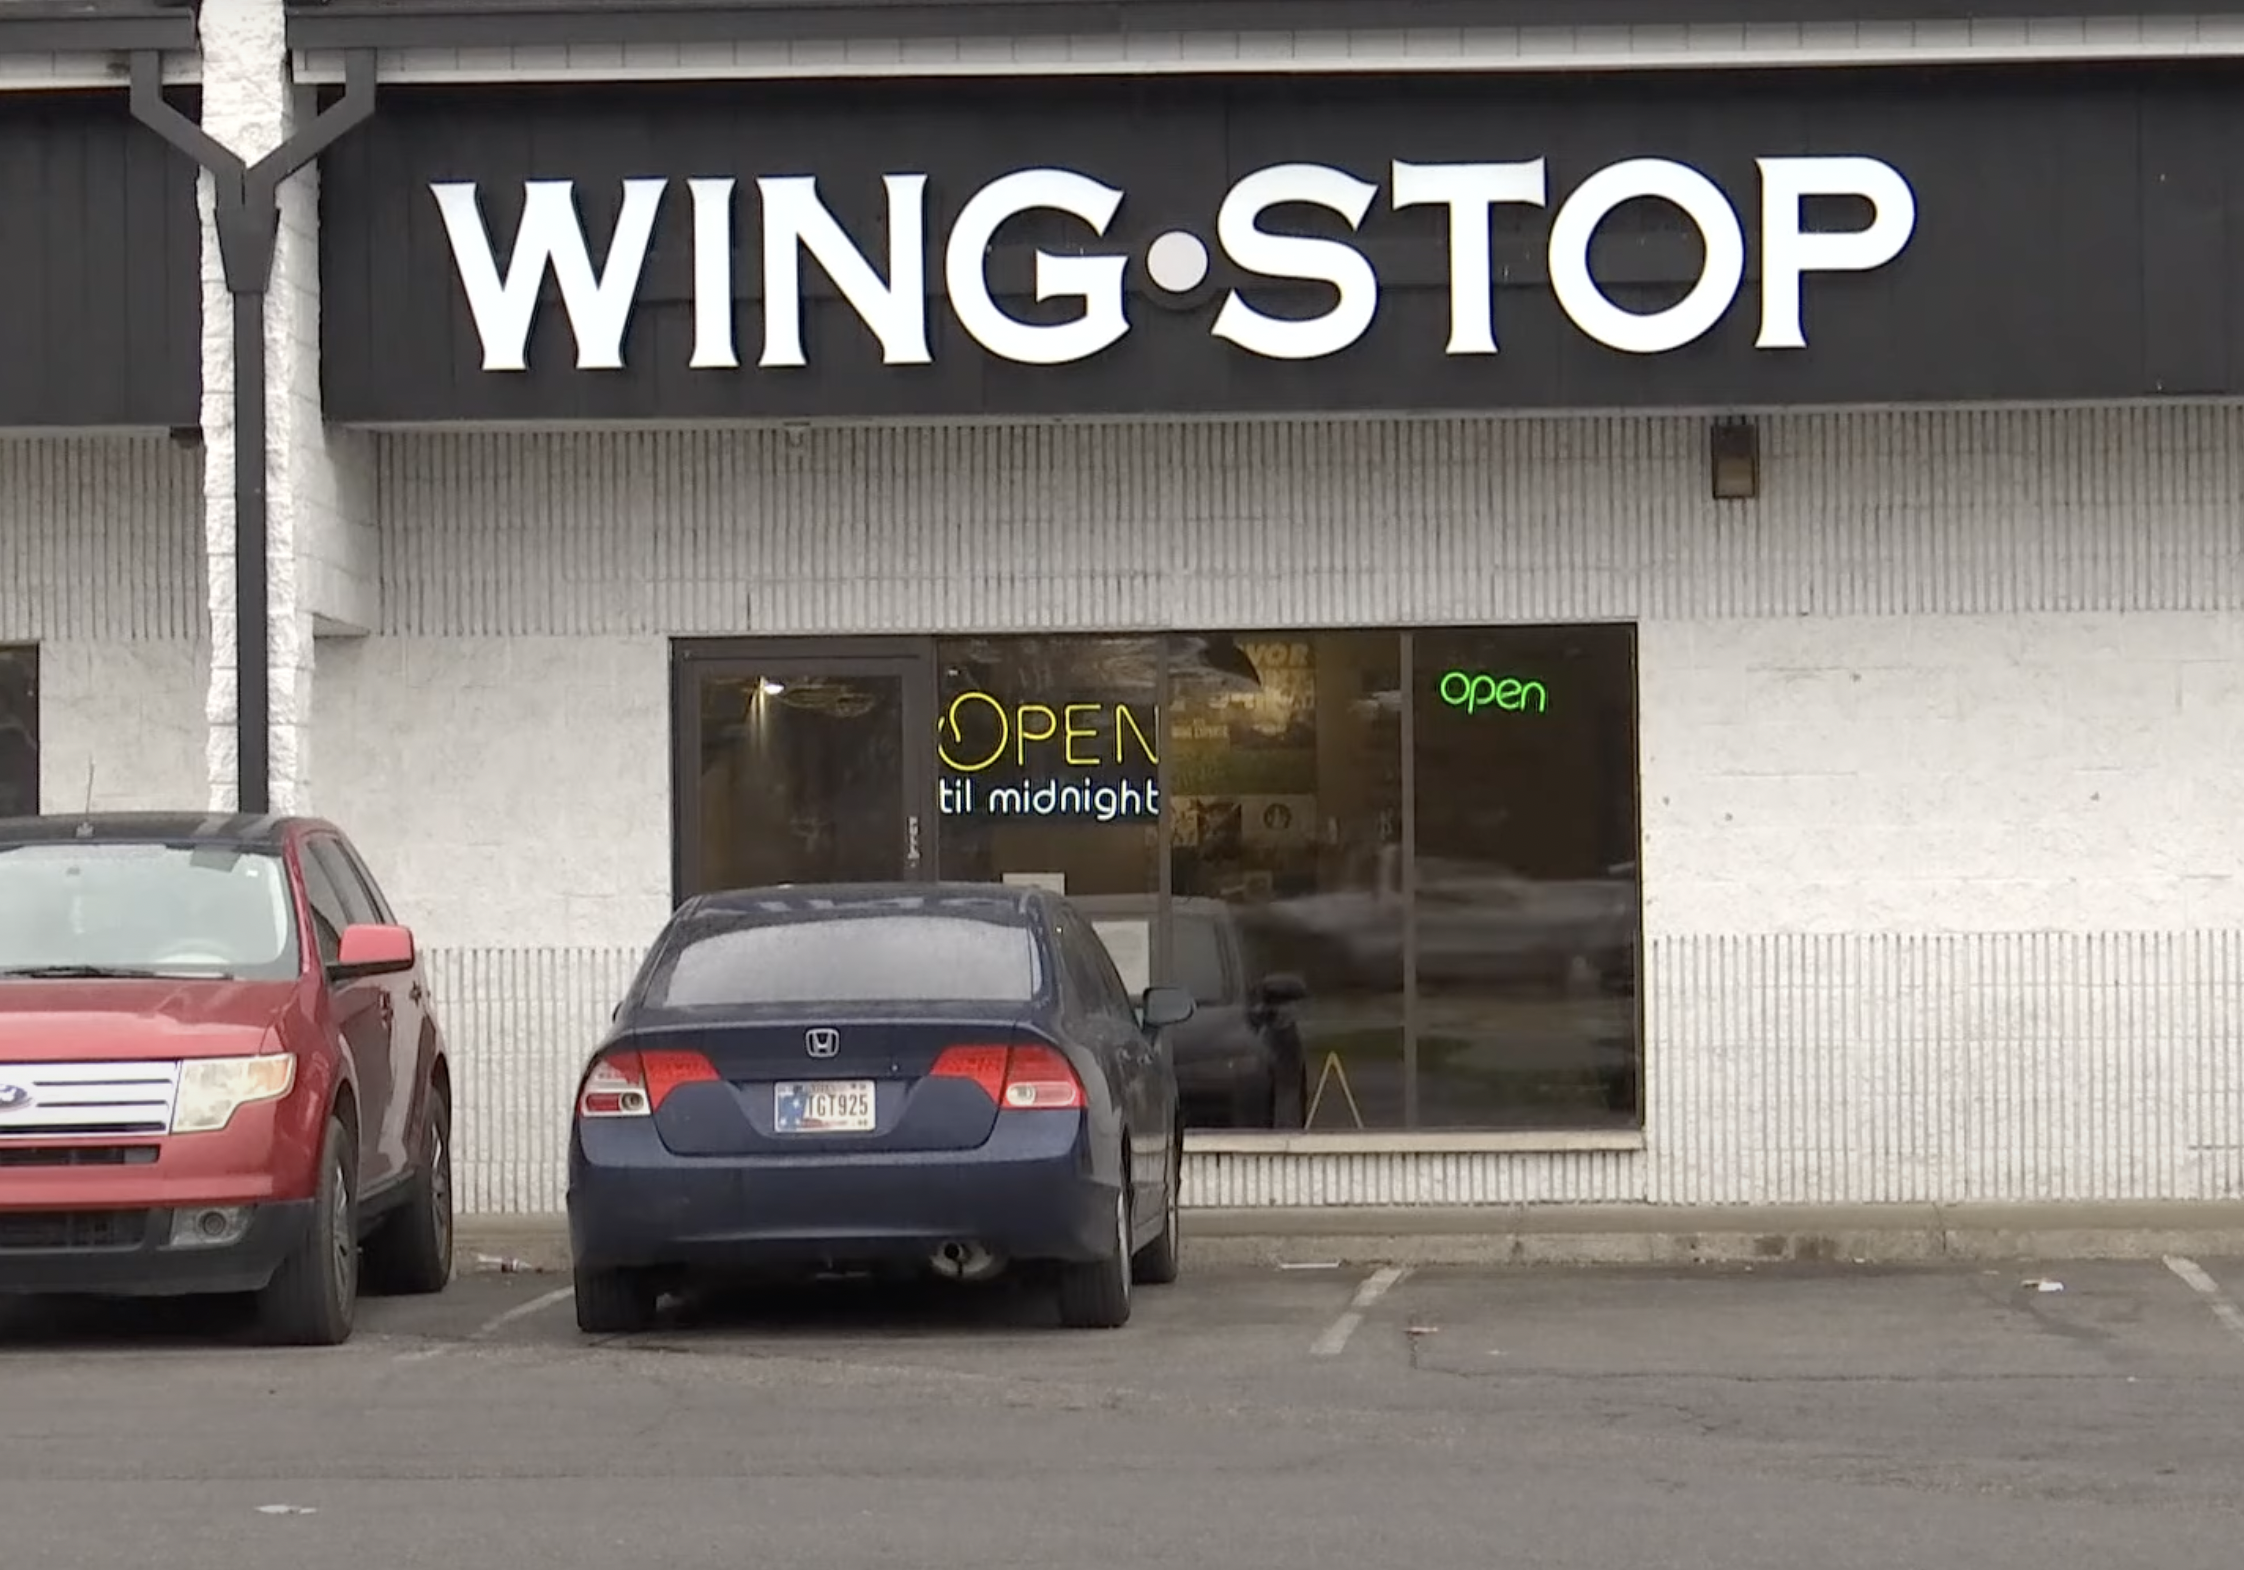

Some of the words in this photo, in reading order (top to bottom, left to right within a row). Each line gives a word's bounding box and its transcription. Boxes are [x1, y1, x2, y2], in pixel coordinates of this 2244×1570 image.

[1439, 670, 1547, 715] open
[938, 691, 1159, 772] OPEN
[988, 777, 1160, 821] midnight
[808, 1093, 868, 1117] TGT925
